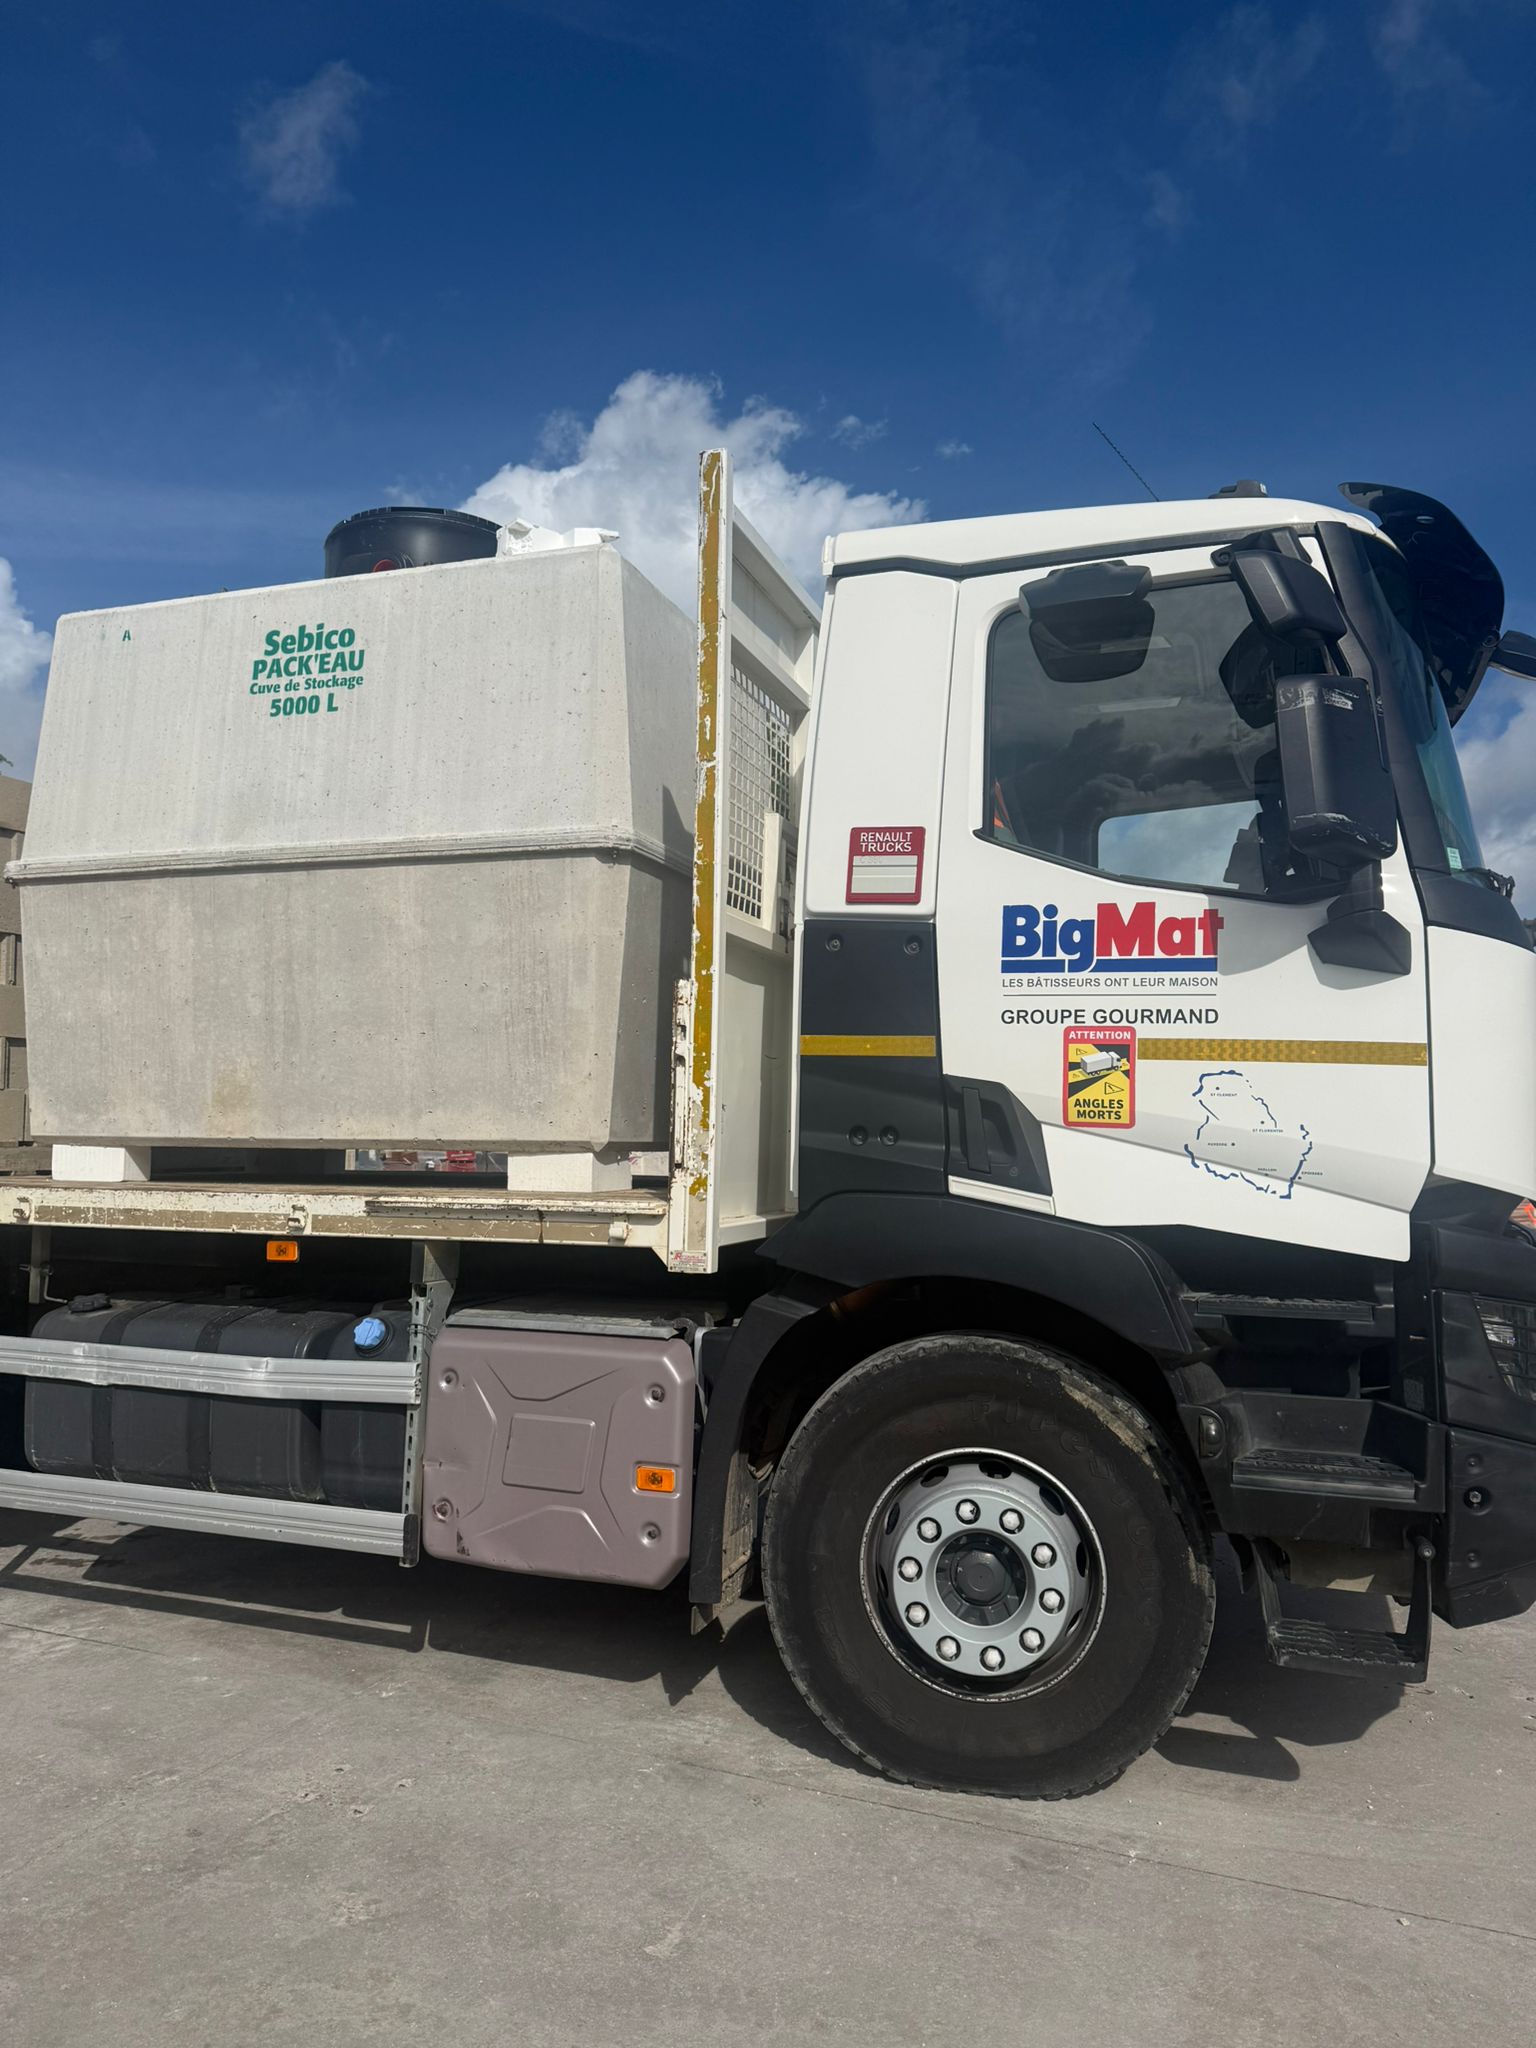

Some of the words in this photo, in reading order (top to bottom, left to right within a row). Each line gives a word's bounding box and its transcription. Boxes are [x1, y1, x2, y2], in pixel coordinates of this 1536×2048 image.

[264, 623, 355, 656] Sebico
[252, 649, 365, 680] PACK'EAU
[250, 683, 281, 695] Cuve
[284, 679, 300, 692] de
[304, 675, 364, 690] Stockage
[269, 695, 320, 717] 5000
[326, 693, 339, 712] L
[860, 831, 913, 842] RENAULT
[860, 842, 912, 852] TRUCKS
[1001, 902, 1224, 973] BigMat
[1002, 978, 1024, 988] LES
[1027, 976, 1101, 988] BÂTISSEURS
[1104, 977, 1129, 988] ONT
[1132, 977, 1166, 987] LEUR
[1169, 977, 1218, 987] MAISON
[1001, 1009, 1086, 1025] GROUPE
[1093, 1008, 1219, 1024] GOURMAND
[1069, 1031, 1131, 1040] ATTENTION
[1074, 1099, 1124, 1109] ANGLES
[1077, 1109, 1122, 1120] MORTS
